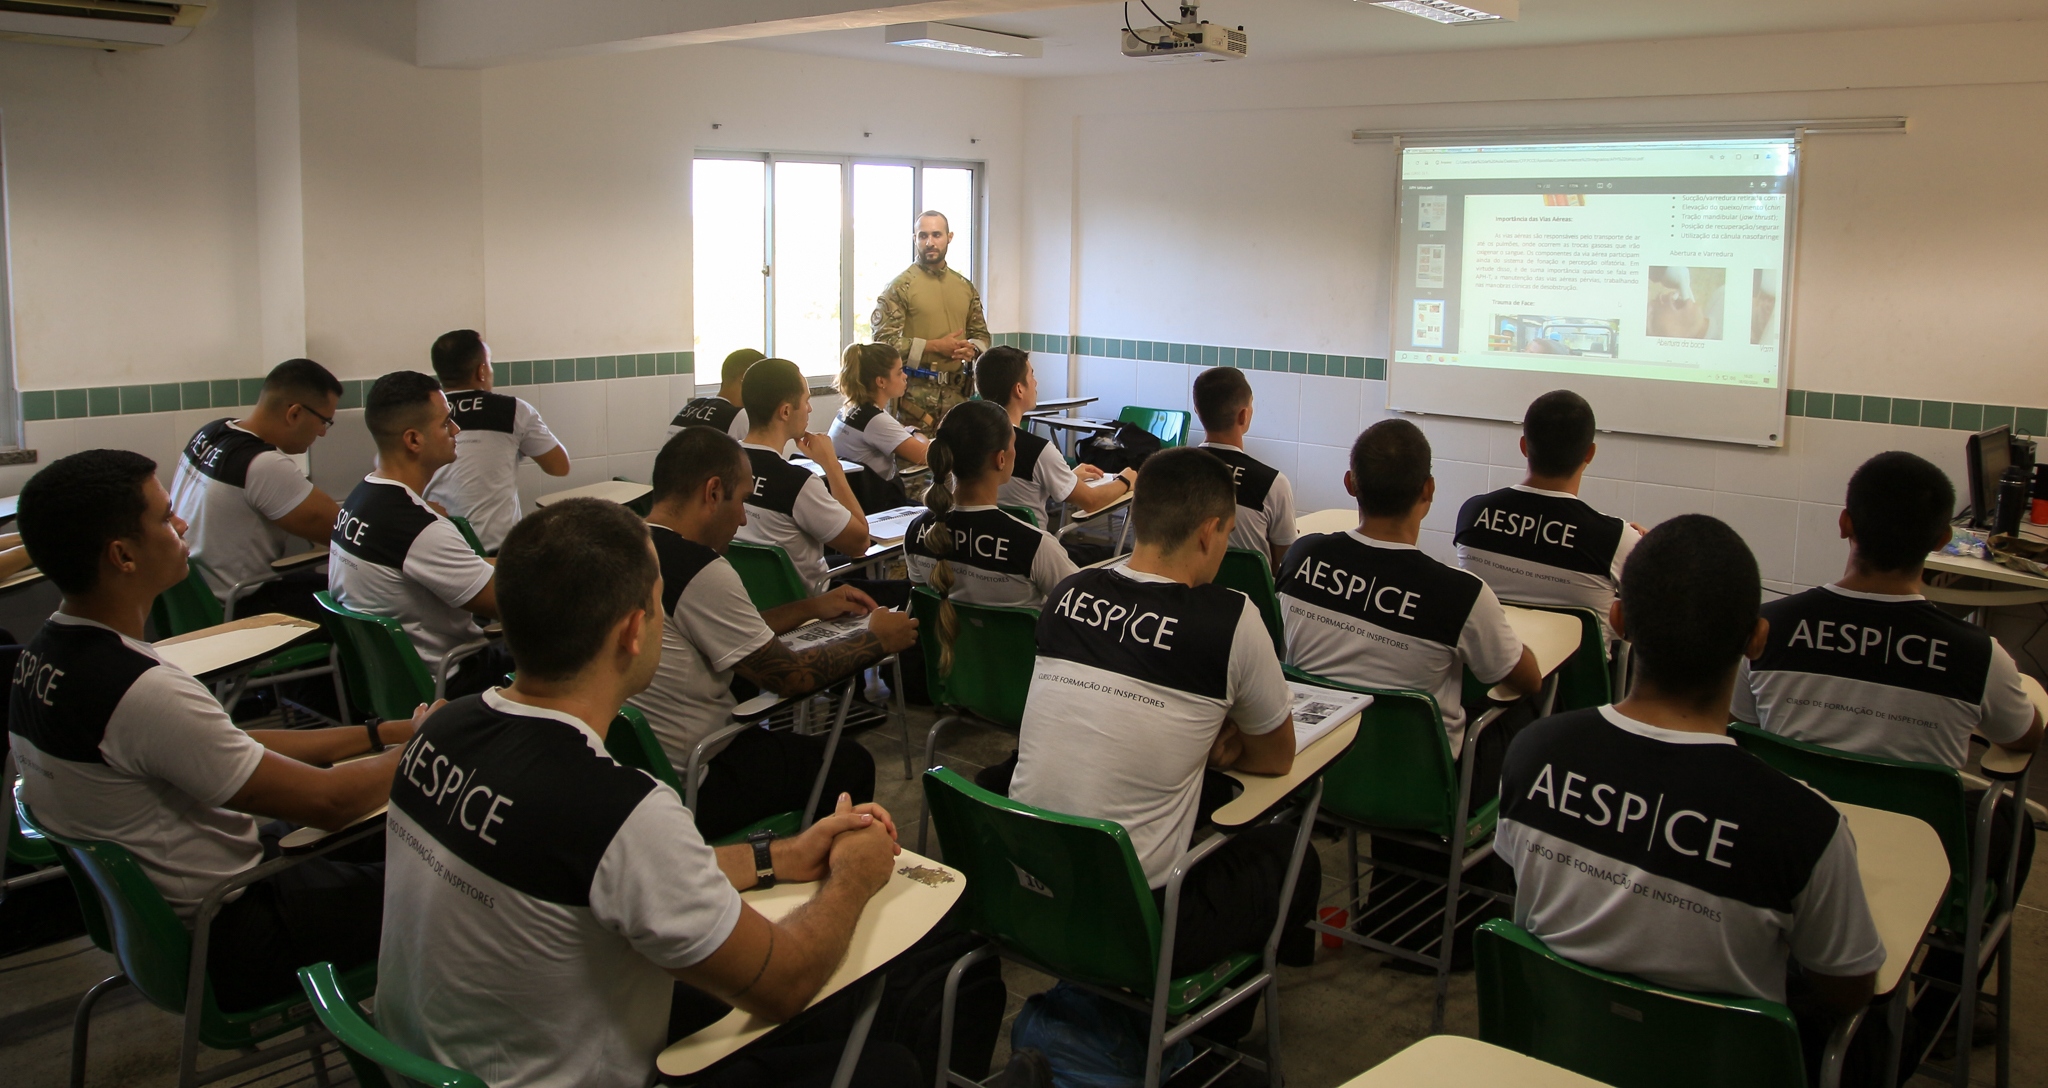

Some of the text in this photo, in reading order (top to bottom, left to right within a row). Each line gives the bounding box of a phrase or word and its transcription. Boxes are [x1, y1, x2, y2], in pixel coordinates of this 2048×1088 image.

[333, 508, 369, 546] SP|CE
[916, 523, 1010, 561] AP|CE
[1484, 558, 1492, 567] DE
[1492, 562, 1525, 575] FORMAÇÃO
[1535, 573, 1571, 585] INSPETORES
[1289, 605, 1409, 651] CURSO DE FORMAÇÃO DE INSPETORES
[13, 650, 65, 706] SP|CE
[1060, 676, 1101, 692] FORMAÇÃO
[1101, 685, 1112, 695] DE
[1114, 688, 1165, 709] INSPETORES
[1812, 700, 1823, 708] DE
[1824, 702, 1874, 715] FORMAÇÃO
[1875, 711, 1886, 720] DE
[1887, 713, 1939, 730] INSPETORES
[397, 826, 406, 841] DE
[405, 832, 435, 867] FORMAÇÃO
[434, 860, 444, 877] DE
[443, 868, 496, 909] INSPETORES
[1556, 852, 1572, 867] DE
[1574, 859, 1632, 890] FORMAÇÃO
[1633, 881, 1649, 897] DE
[1652, 889, 1722, 923] INSPETORES
